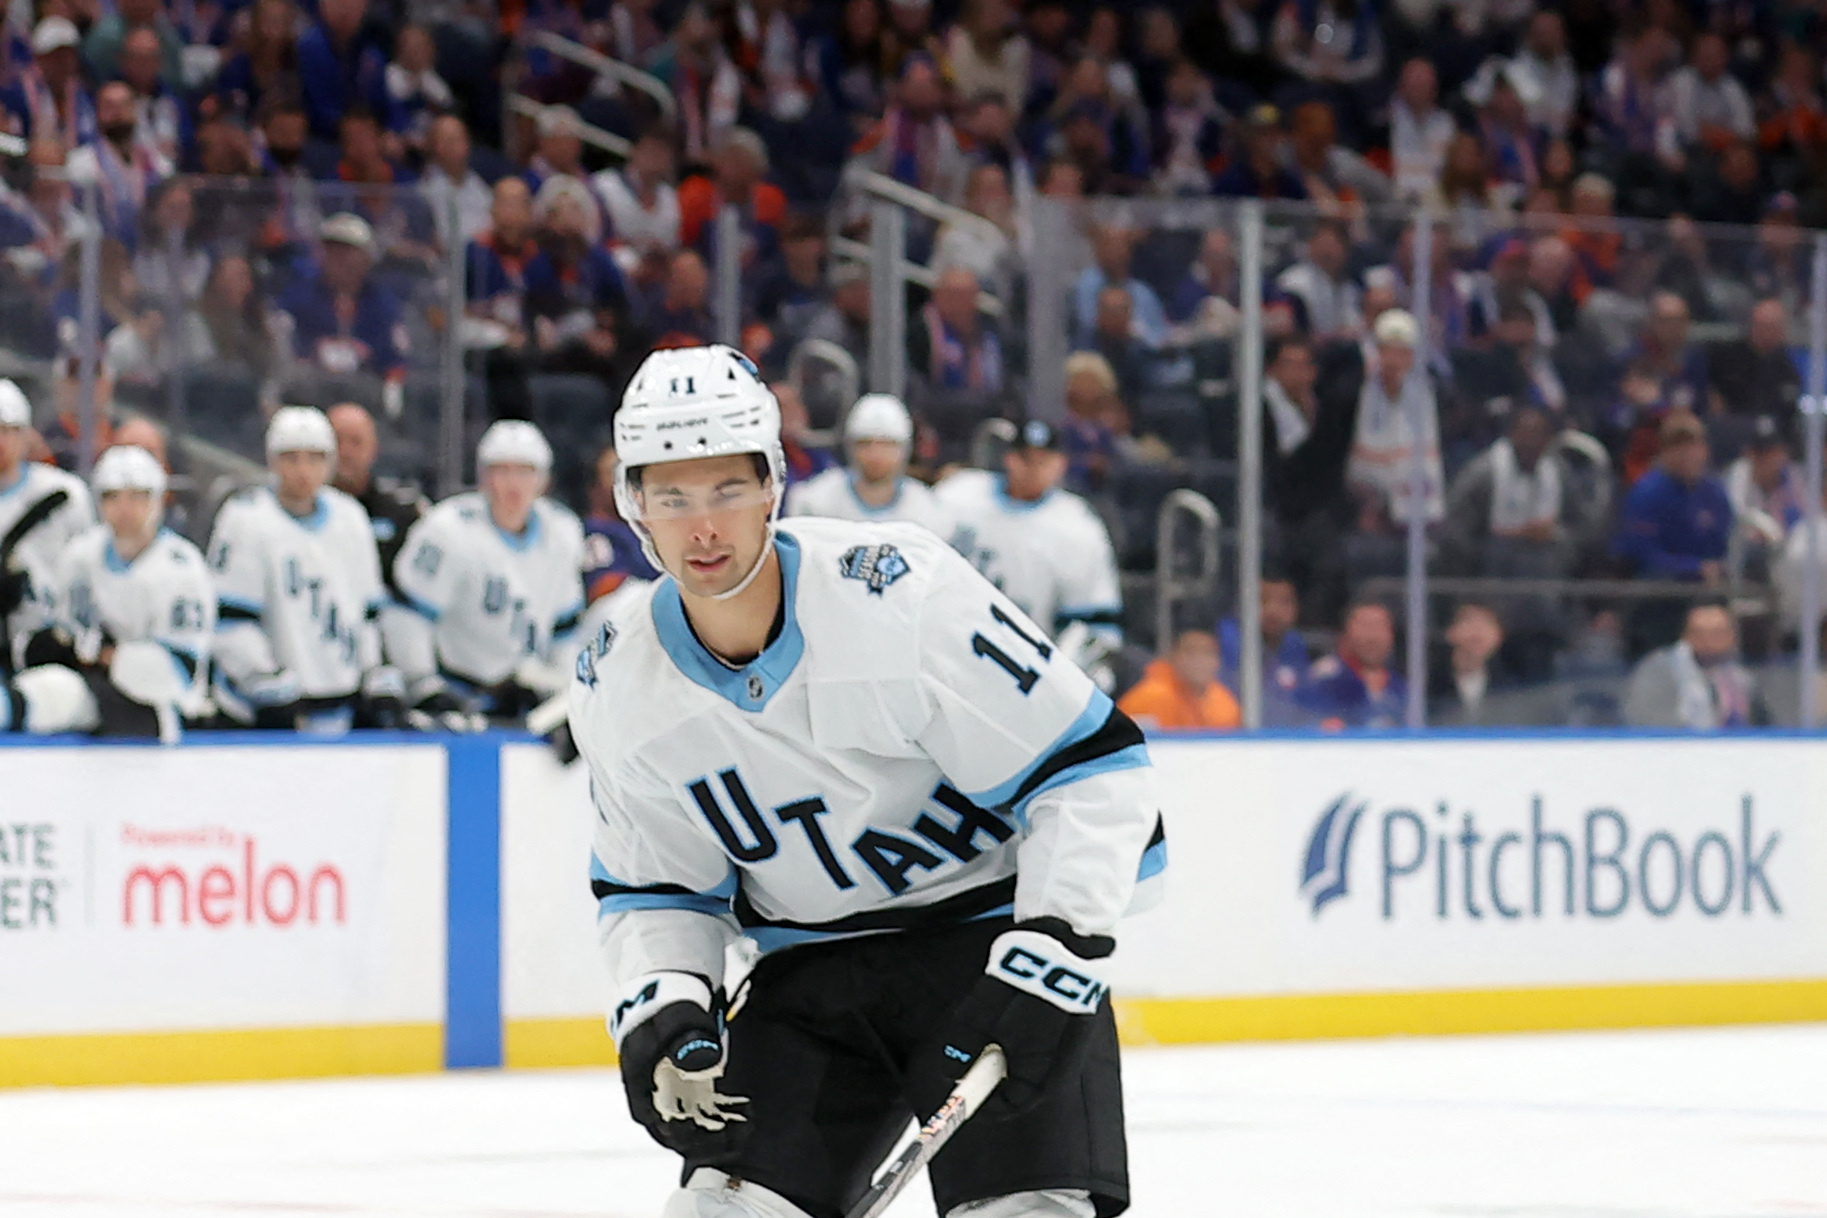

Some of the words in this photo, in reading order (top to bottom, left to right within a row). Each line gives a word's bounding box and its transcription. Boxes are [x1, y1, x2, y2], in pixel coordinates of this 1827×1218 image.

[969, 602, 1053, 697] 11
[122, 834, 348, 927] melon
[685, 764, 1017, 897] UTAH
[1380, 793, 1784, 921] PitchBook
